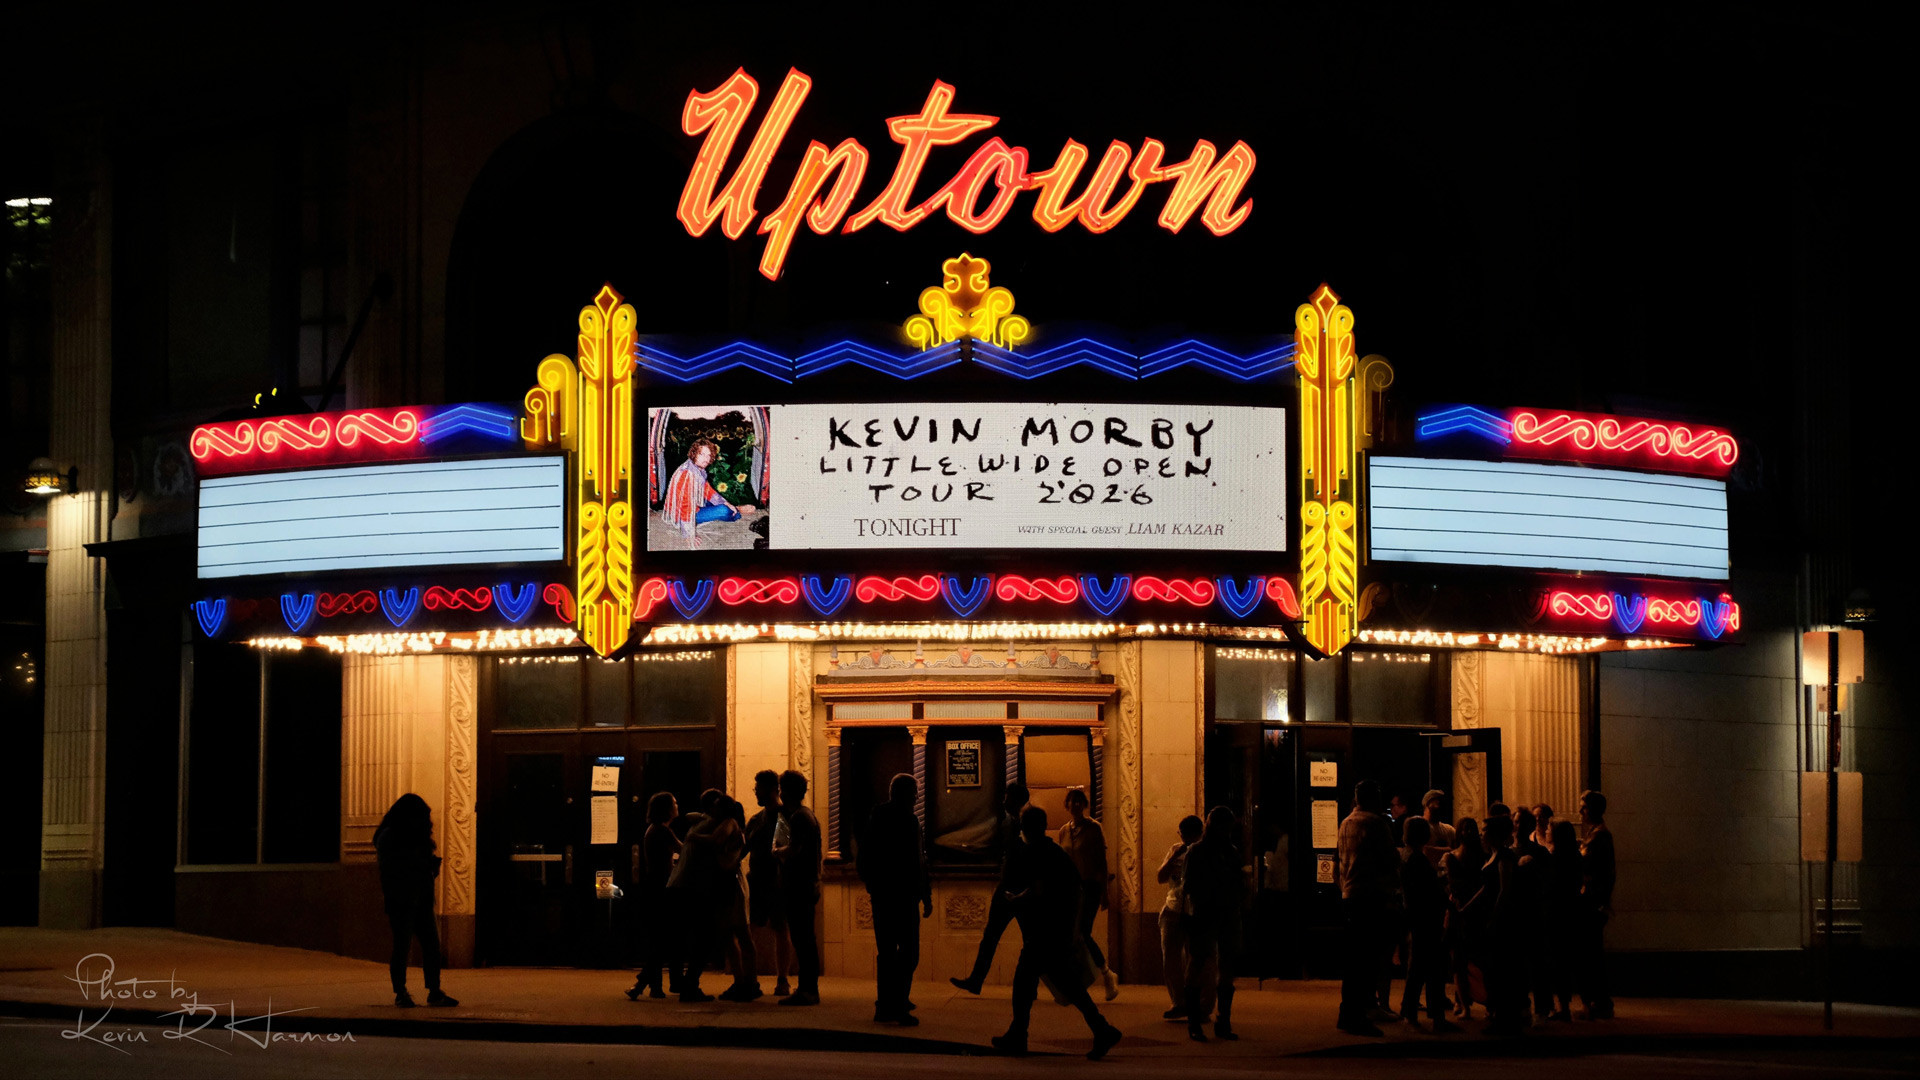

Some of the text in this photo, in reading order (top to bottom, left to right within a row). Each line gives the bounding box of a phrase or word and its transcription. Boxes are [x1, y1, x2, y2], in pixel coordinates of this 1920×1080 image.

[677, 67, 1257, 280] Uptown
[829, 416, 1214, 457] KEVIN MORBY
[820, 454, 1212, 478] LITTLE WIDE OPEN
[868, 481, 1154, 505] TOUR 2026
[854, 518, 962, 537] TONIGHT
[1018, 522, 1225, 536] WITH SPECIAL GUEST LIAM KAZAR
[960, 742, 979, 750] OFFICE
